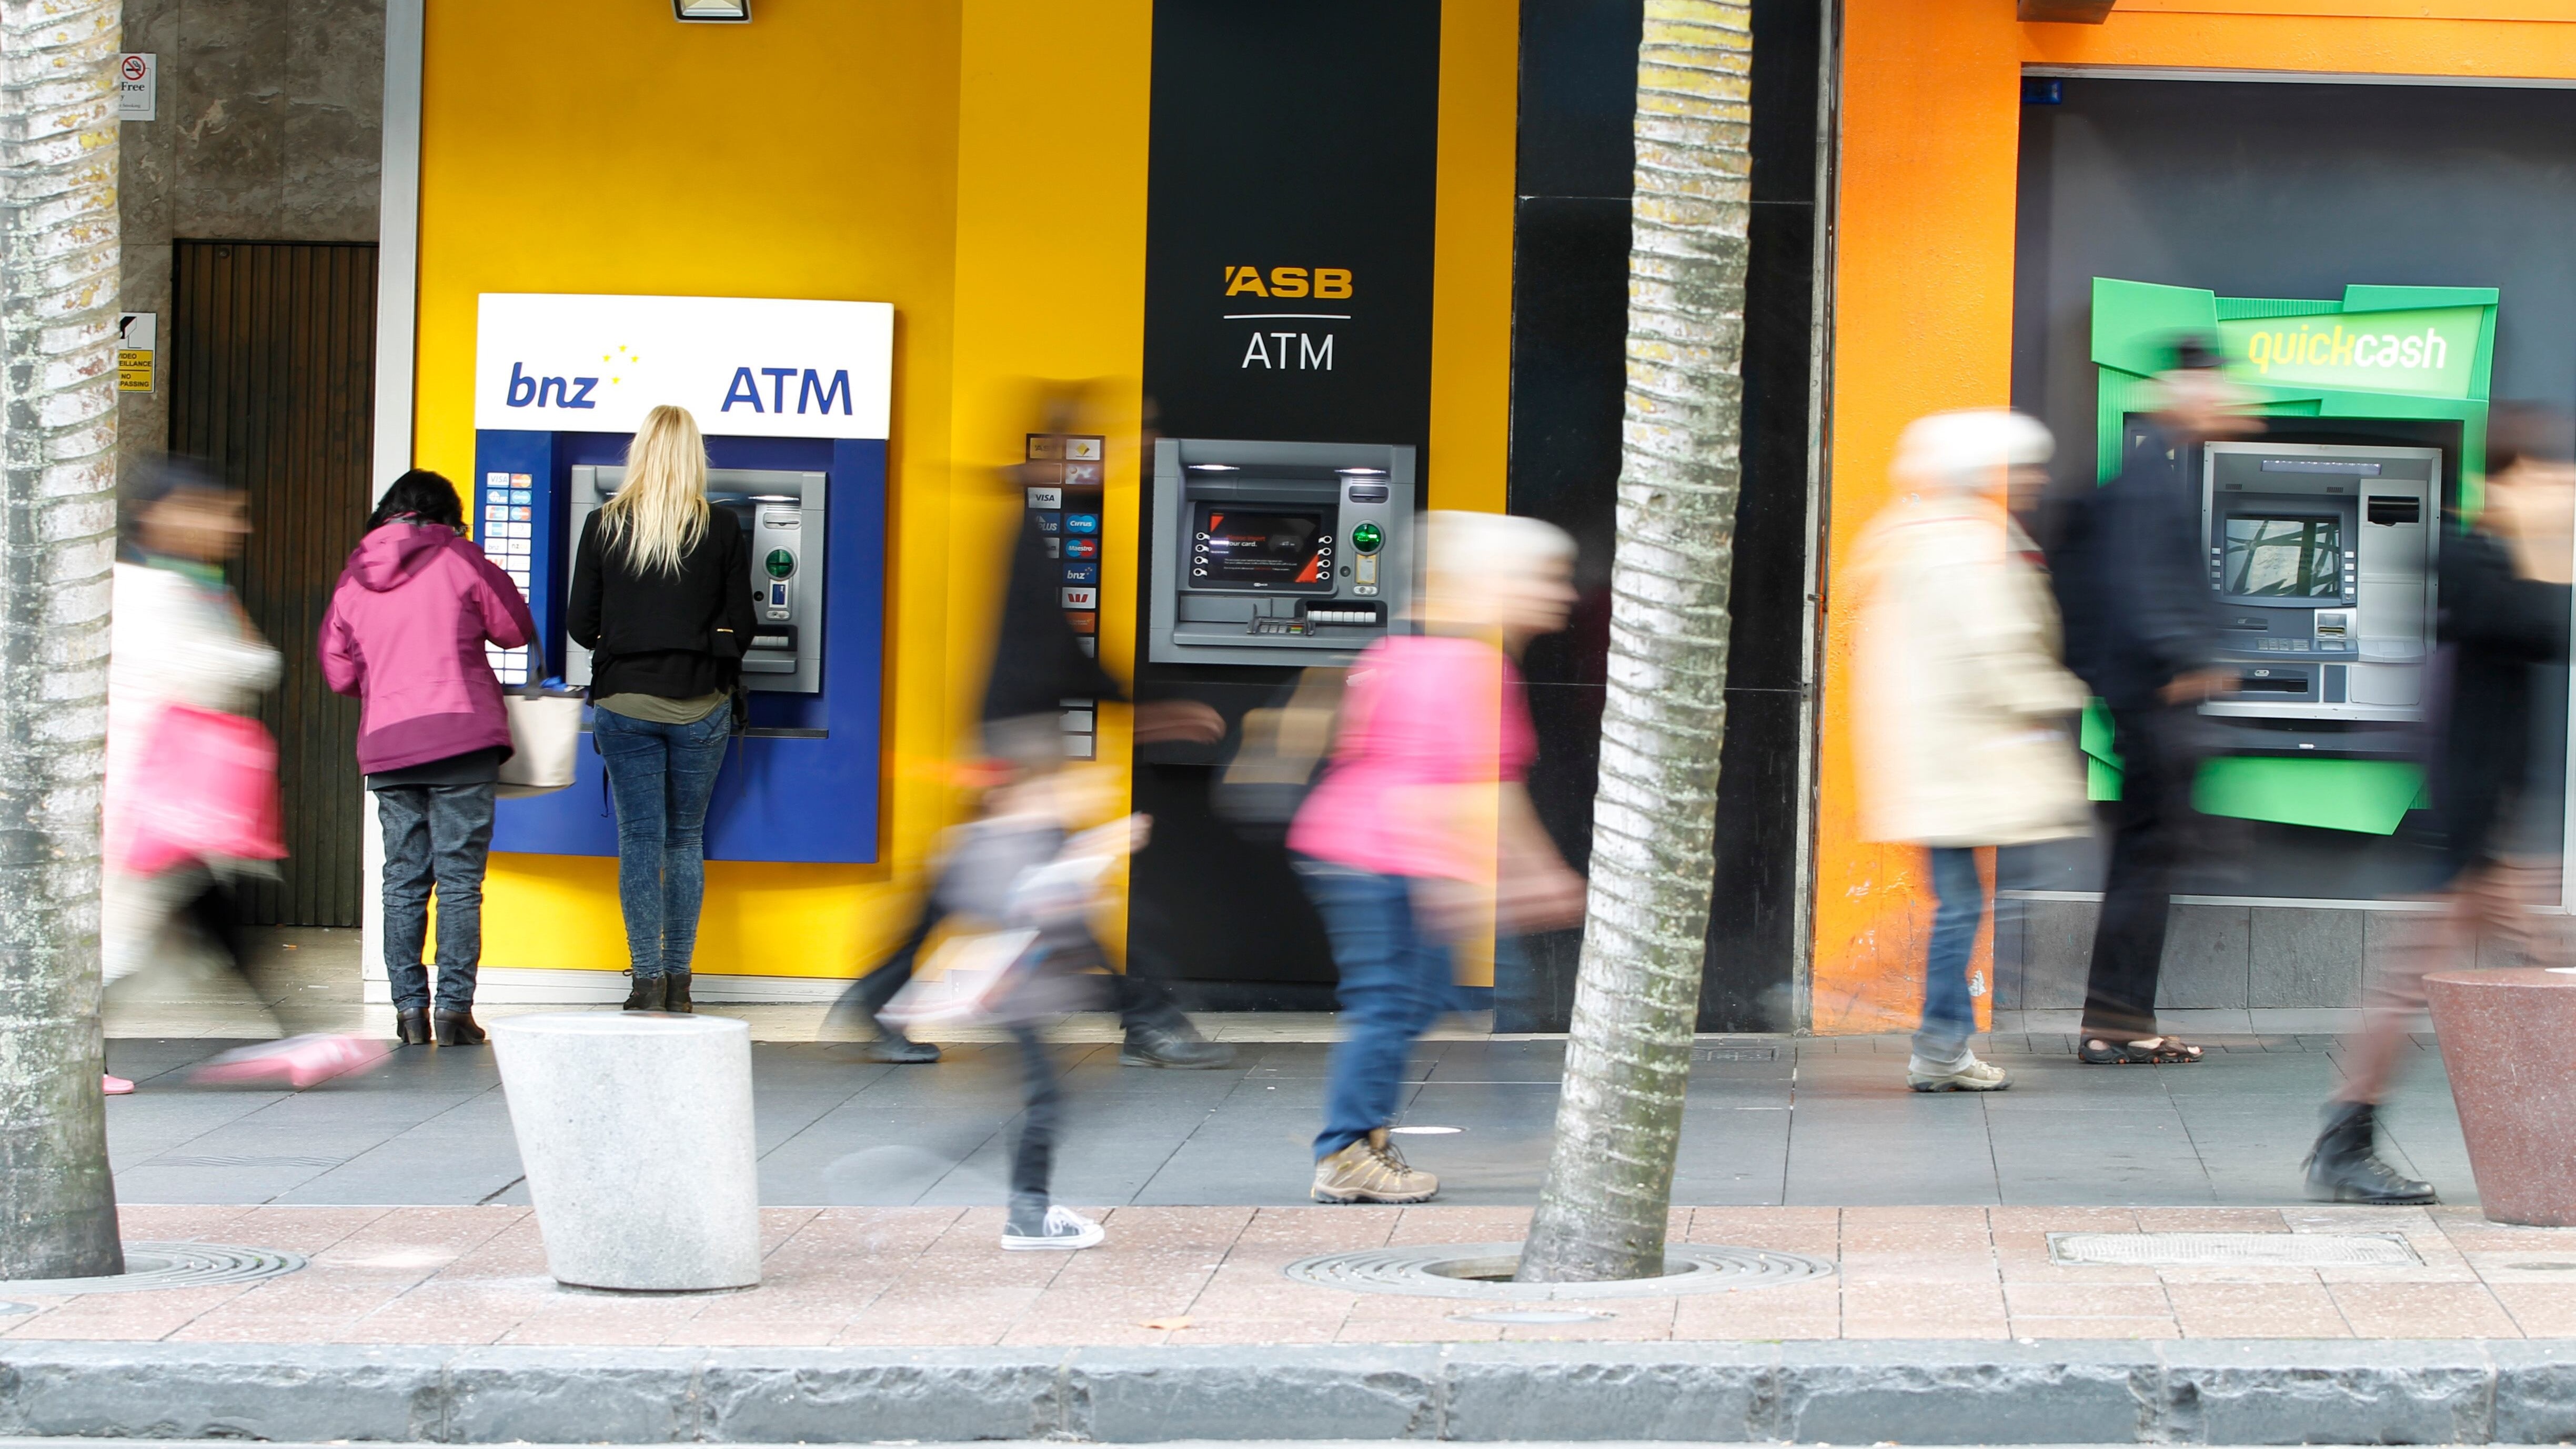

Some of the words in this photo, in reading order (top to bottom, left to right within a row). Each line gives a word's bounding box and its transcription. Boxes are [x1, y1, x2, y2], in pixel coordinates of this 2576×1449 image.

[120, 82, 145, 91] Free
[1225, 266, 1353, 299] ASB
[1242, 332, 1333, 370] ATM
[2249, 324, 2447, 374] quickcash
[506, 361, 599, 409] bnz
[721, 367, 853, 415] ATM
[1067, 570, 1085, 579] bnz
